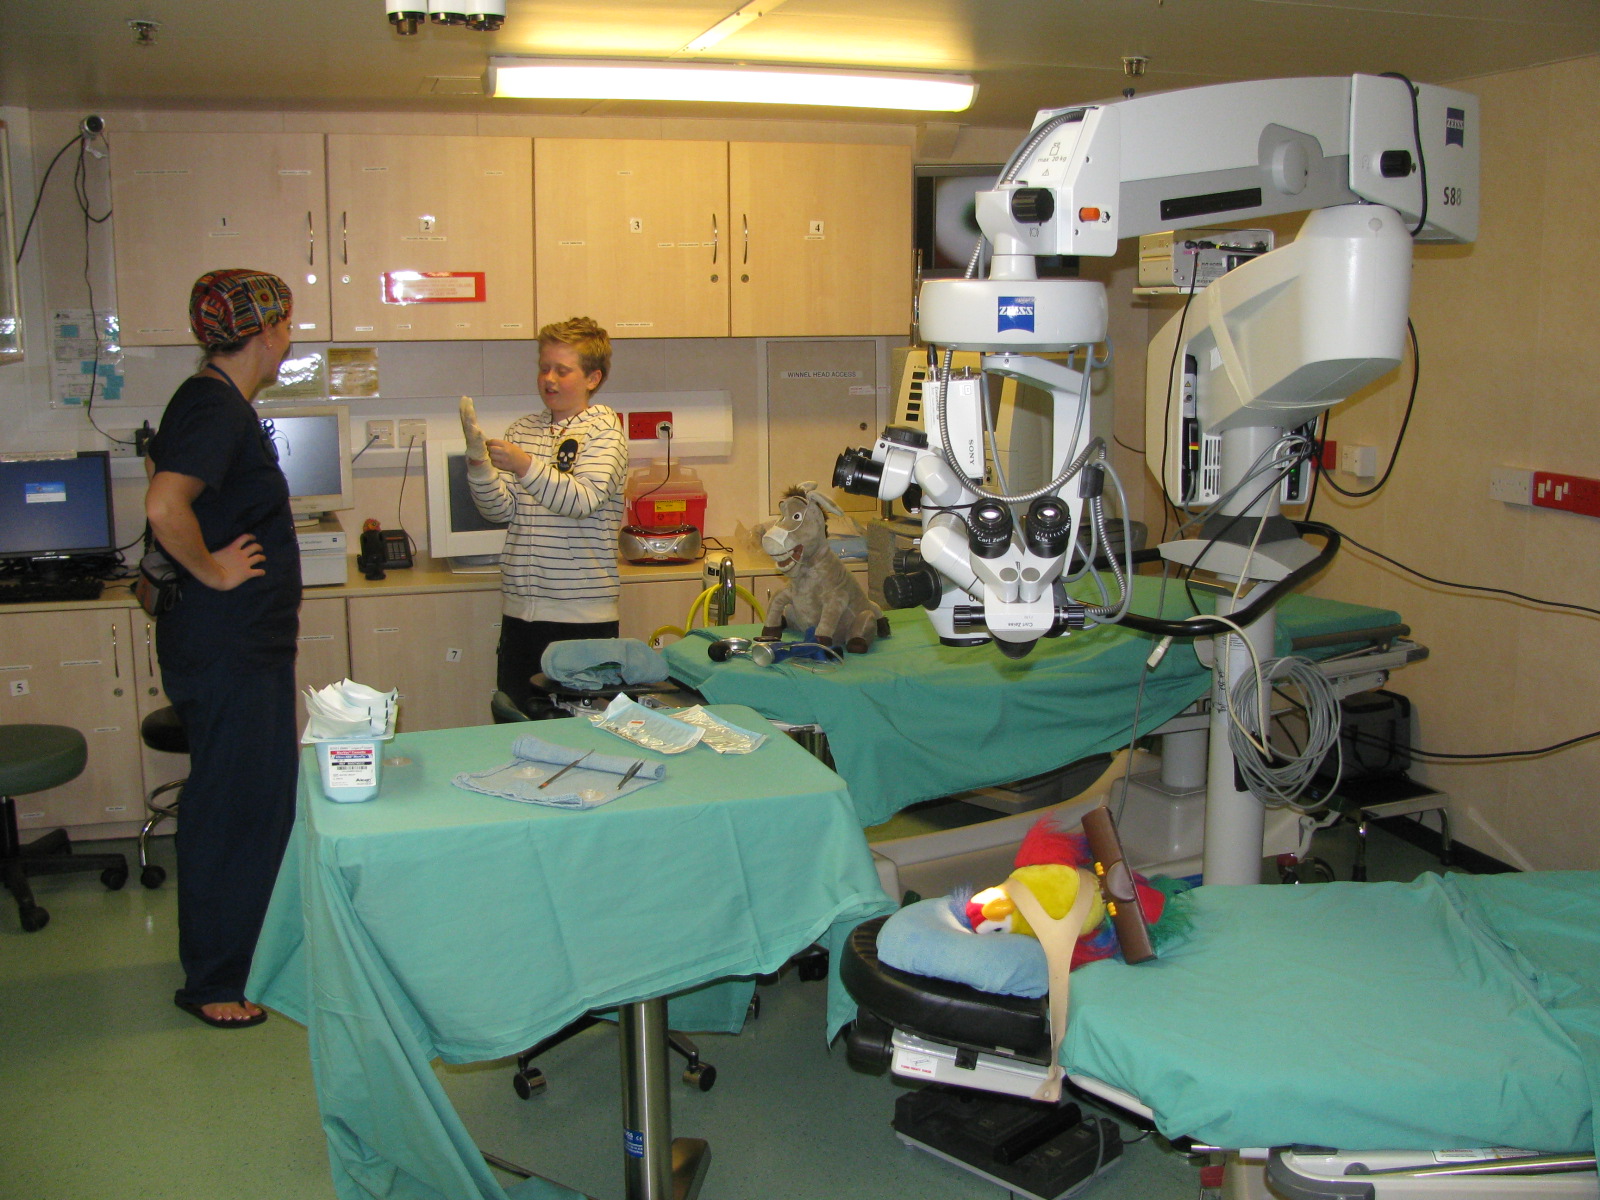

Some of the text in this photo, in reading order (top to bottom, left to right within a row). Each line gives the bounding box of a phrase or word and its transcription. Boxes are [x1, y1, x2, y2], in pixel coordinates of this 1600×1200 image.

[1446, 118, 1465, 130] ZEISS
[1443, 186, 1462, 206] S88
[423, 221, 430, 230] 2
[634, 221, 640, 230] 3
[815, 223, 821, 232] 4
[998, 306, 1034, 316] ZSS
[977, 534, 1008, 543] Carl Zeiss
[654, 637, 660, 646] 8
[452, 650, 458, 660] 7
[16, 683, 24, 693] 5
